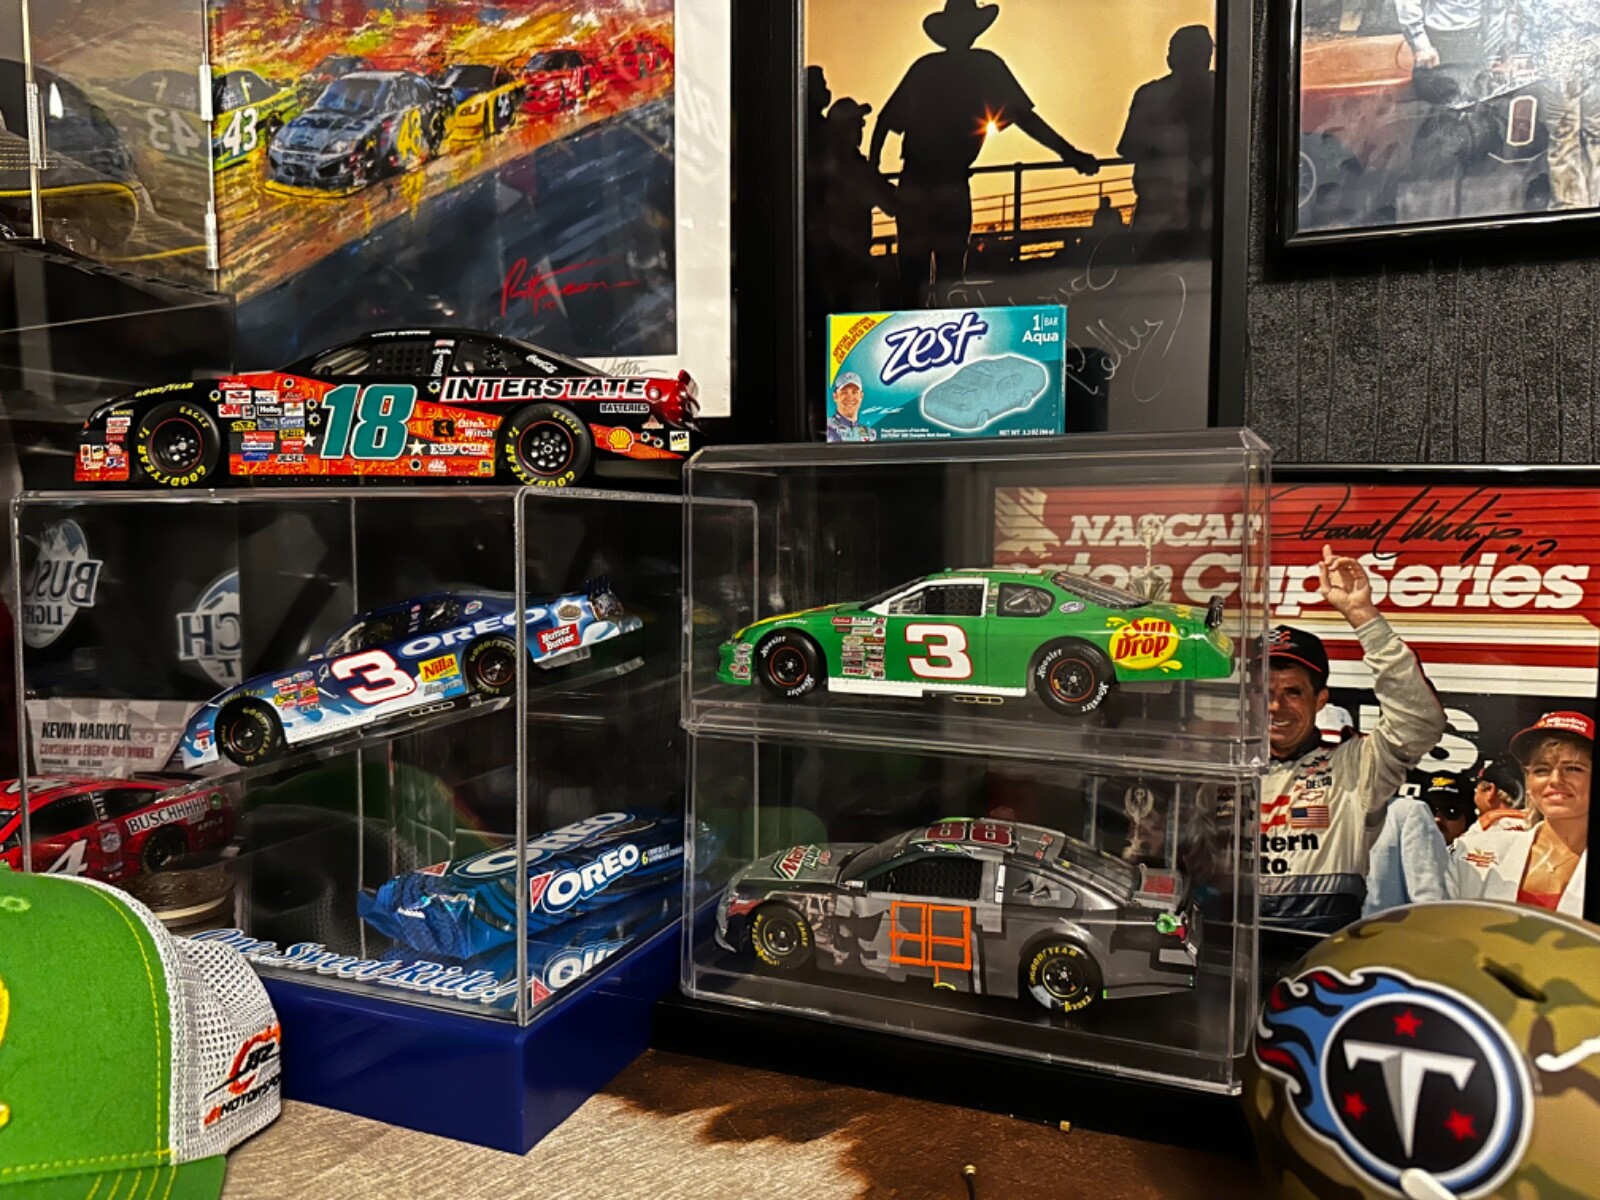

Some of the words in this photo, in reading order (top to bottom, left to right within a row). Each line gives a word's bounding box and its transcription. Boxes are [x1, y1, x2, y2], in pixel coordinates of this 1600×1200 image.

[223, 107, 258, 156] 43
[397, 107, 423, 159] 48
[1033, 314, 1041, 332] 1
[1044, 316, 1060, 327] BAR
[880, 311, 989, 385] Zest
[1022, 331, 1060, 346] Aqua
[441, 376, 649, 402] INTERSTATE
[600, 402, 650, 413] BATTERIES
[320, 384, 417, 460] 18
[457, 418, 485, 430] Ditch
[464, 427, 493, 438] Witch
[1064, 513, 1263, 547] NASCAR
[1181, 552, 1323, 617] Cup
[1356, 553, 1590, 610] Series
[399, 606, 549, 659] OREO
[541, 626, 572, 644] Nutter
[1122, 618, 1172, 639] Sun
[546, 634, 576, 652] Butter
[905, 623, 973, 680] 3
[1114, 633, 1170, 661] Drop
[331, 650, 418, 706] 3
[423, 657, 455, 680] Nilla
[41, 722, 77, 739] KEVIN
[78, 723, 132, 741] HARVICK
[39, 743, 81, 756] CONSUMERS
[82, 744, 110, 757] ENERGY
[111, 746, 126, 758] 400
[127, 746, 155, 759] WINNER
[461, 811, 629, 875] OREO
[641, 851, 649, 866] 6
[546, 843, 640, 907] OREO
[279, 940, 392, 980] Sweet
